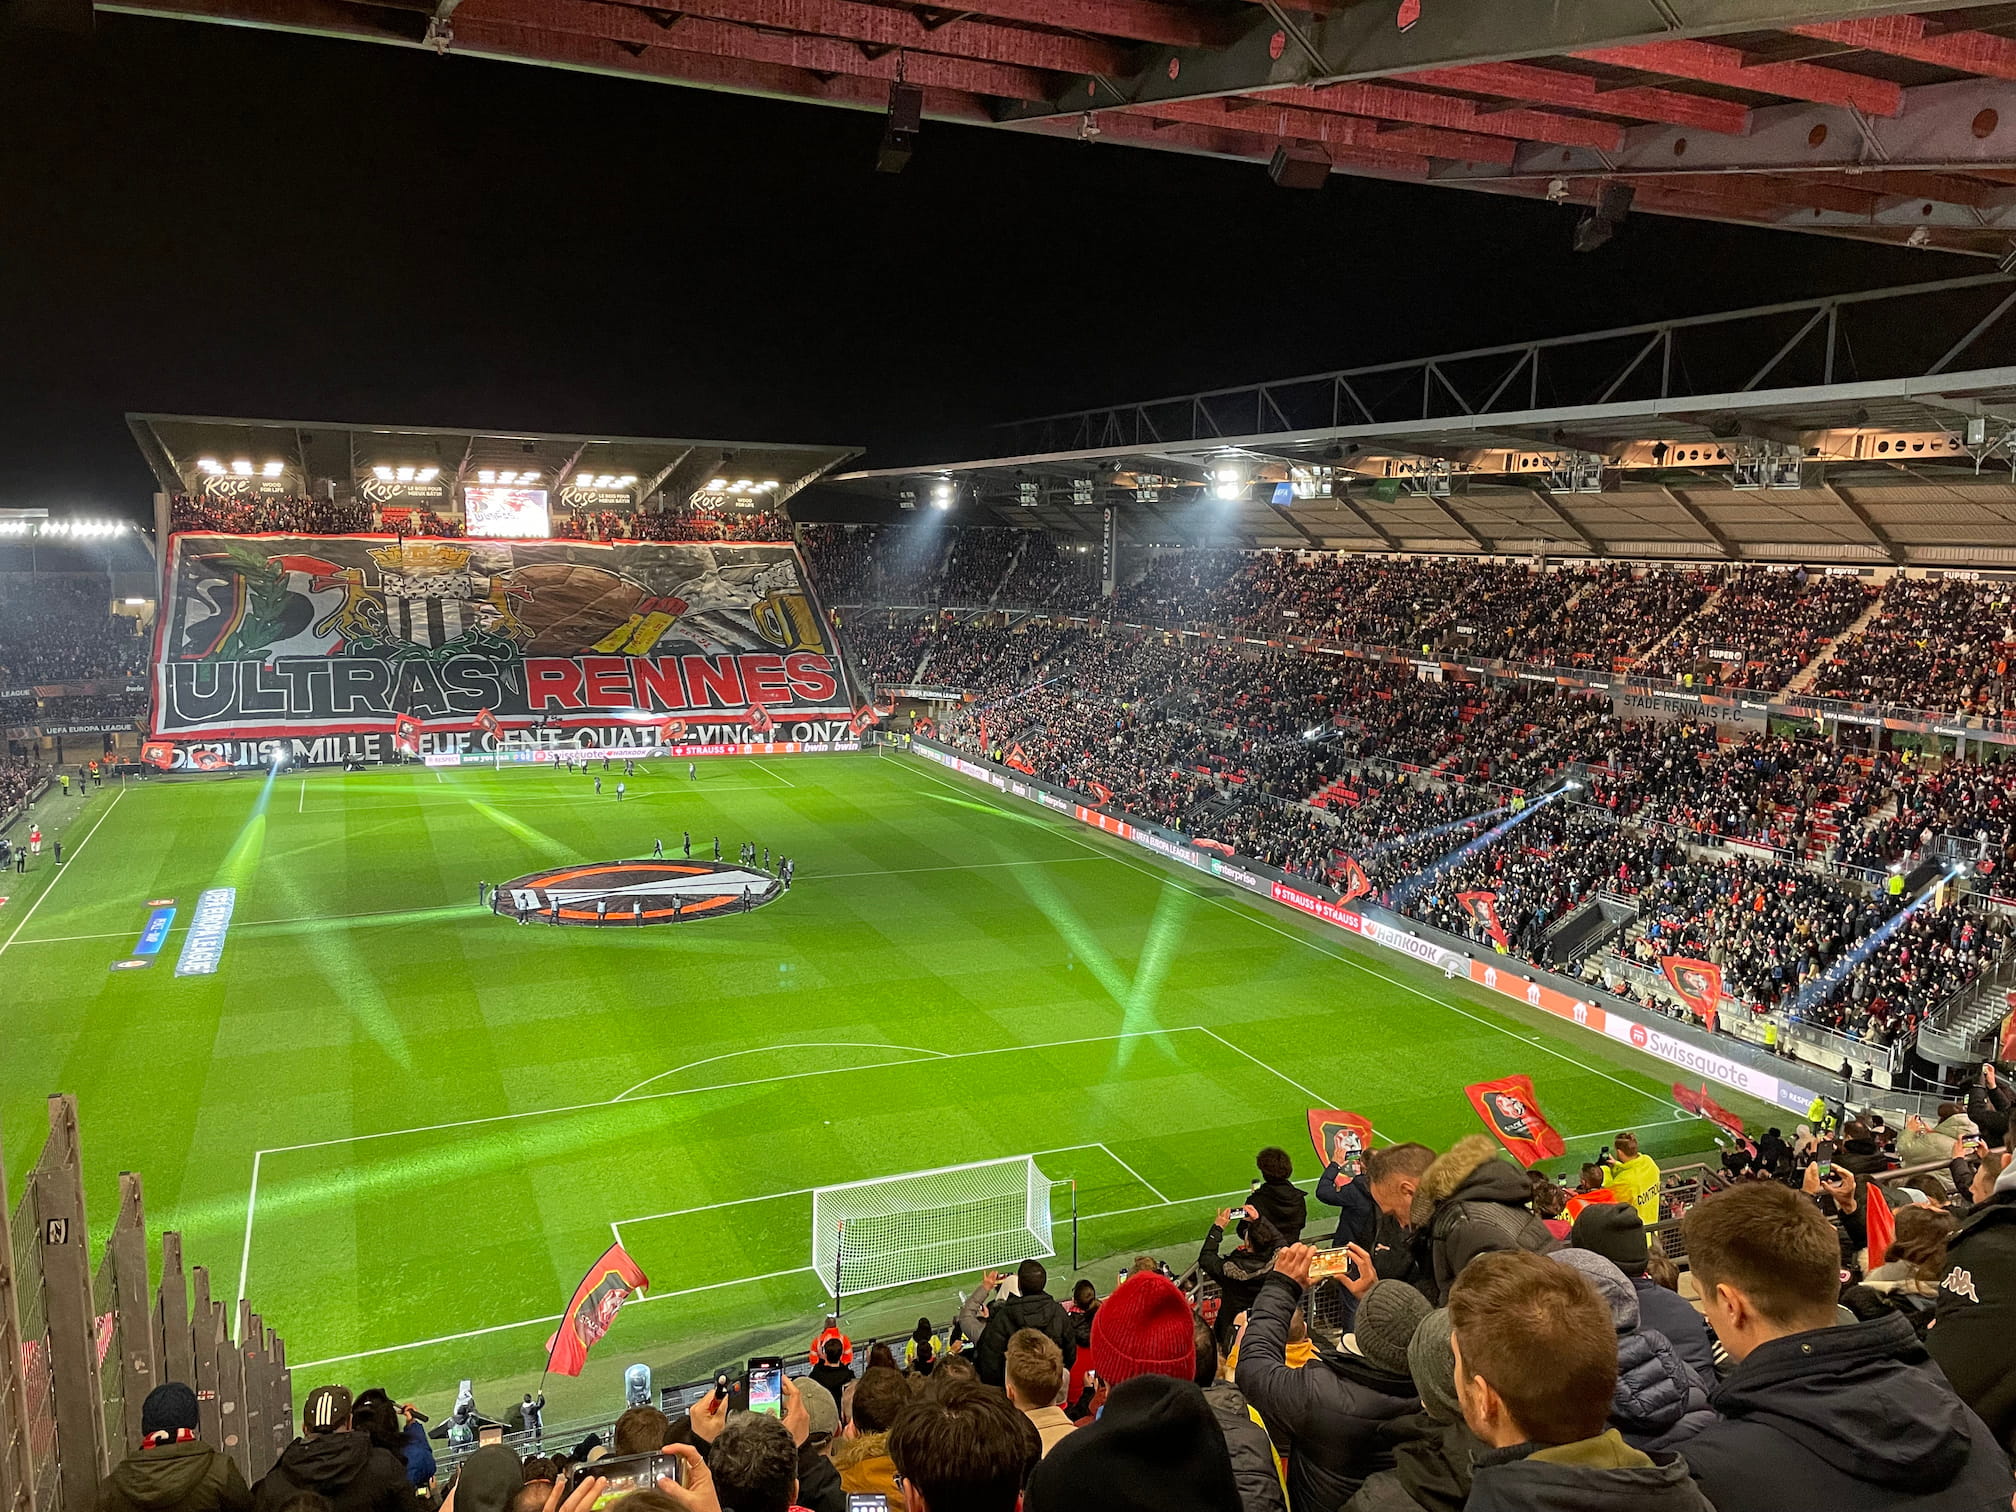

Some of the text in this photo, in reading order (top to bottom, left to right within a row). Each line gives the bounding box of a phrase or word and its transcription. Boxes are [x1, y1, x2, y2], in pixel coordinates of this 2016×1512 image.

[203, 474, 250, 498] Rose
[361, 478, 405, 502] Rose
[560, 486, 598, 508] Rose
[689, 490, 726, 512] Rose
[172, 652, 837, 721] ULTRAS RENNES
[1624, 694, 1744, 722] STADE RENNAIS F.C.
[292, 734, 381, 764] MILLE
[392, 731, 471, 757] EUF
[686, 746, 725, 755] STRAUSS
[804, 741, 828, 752] bwin
[834, 741, 858, 751] bwin
[1170, 844, 1191, 861] LEAGUE
[1212, 862, 1257, 886] enterprise
[1282, 889, 1315, 911] STRAUSS
[1323, 905, 1359, 929] STRAUSS
[1650, 1033, 1749, 1087] Swissquote
